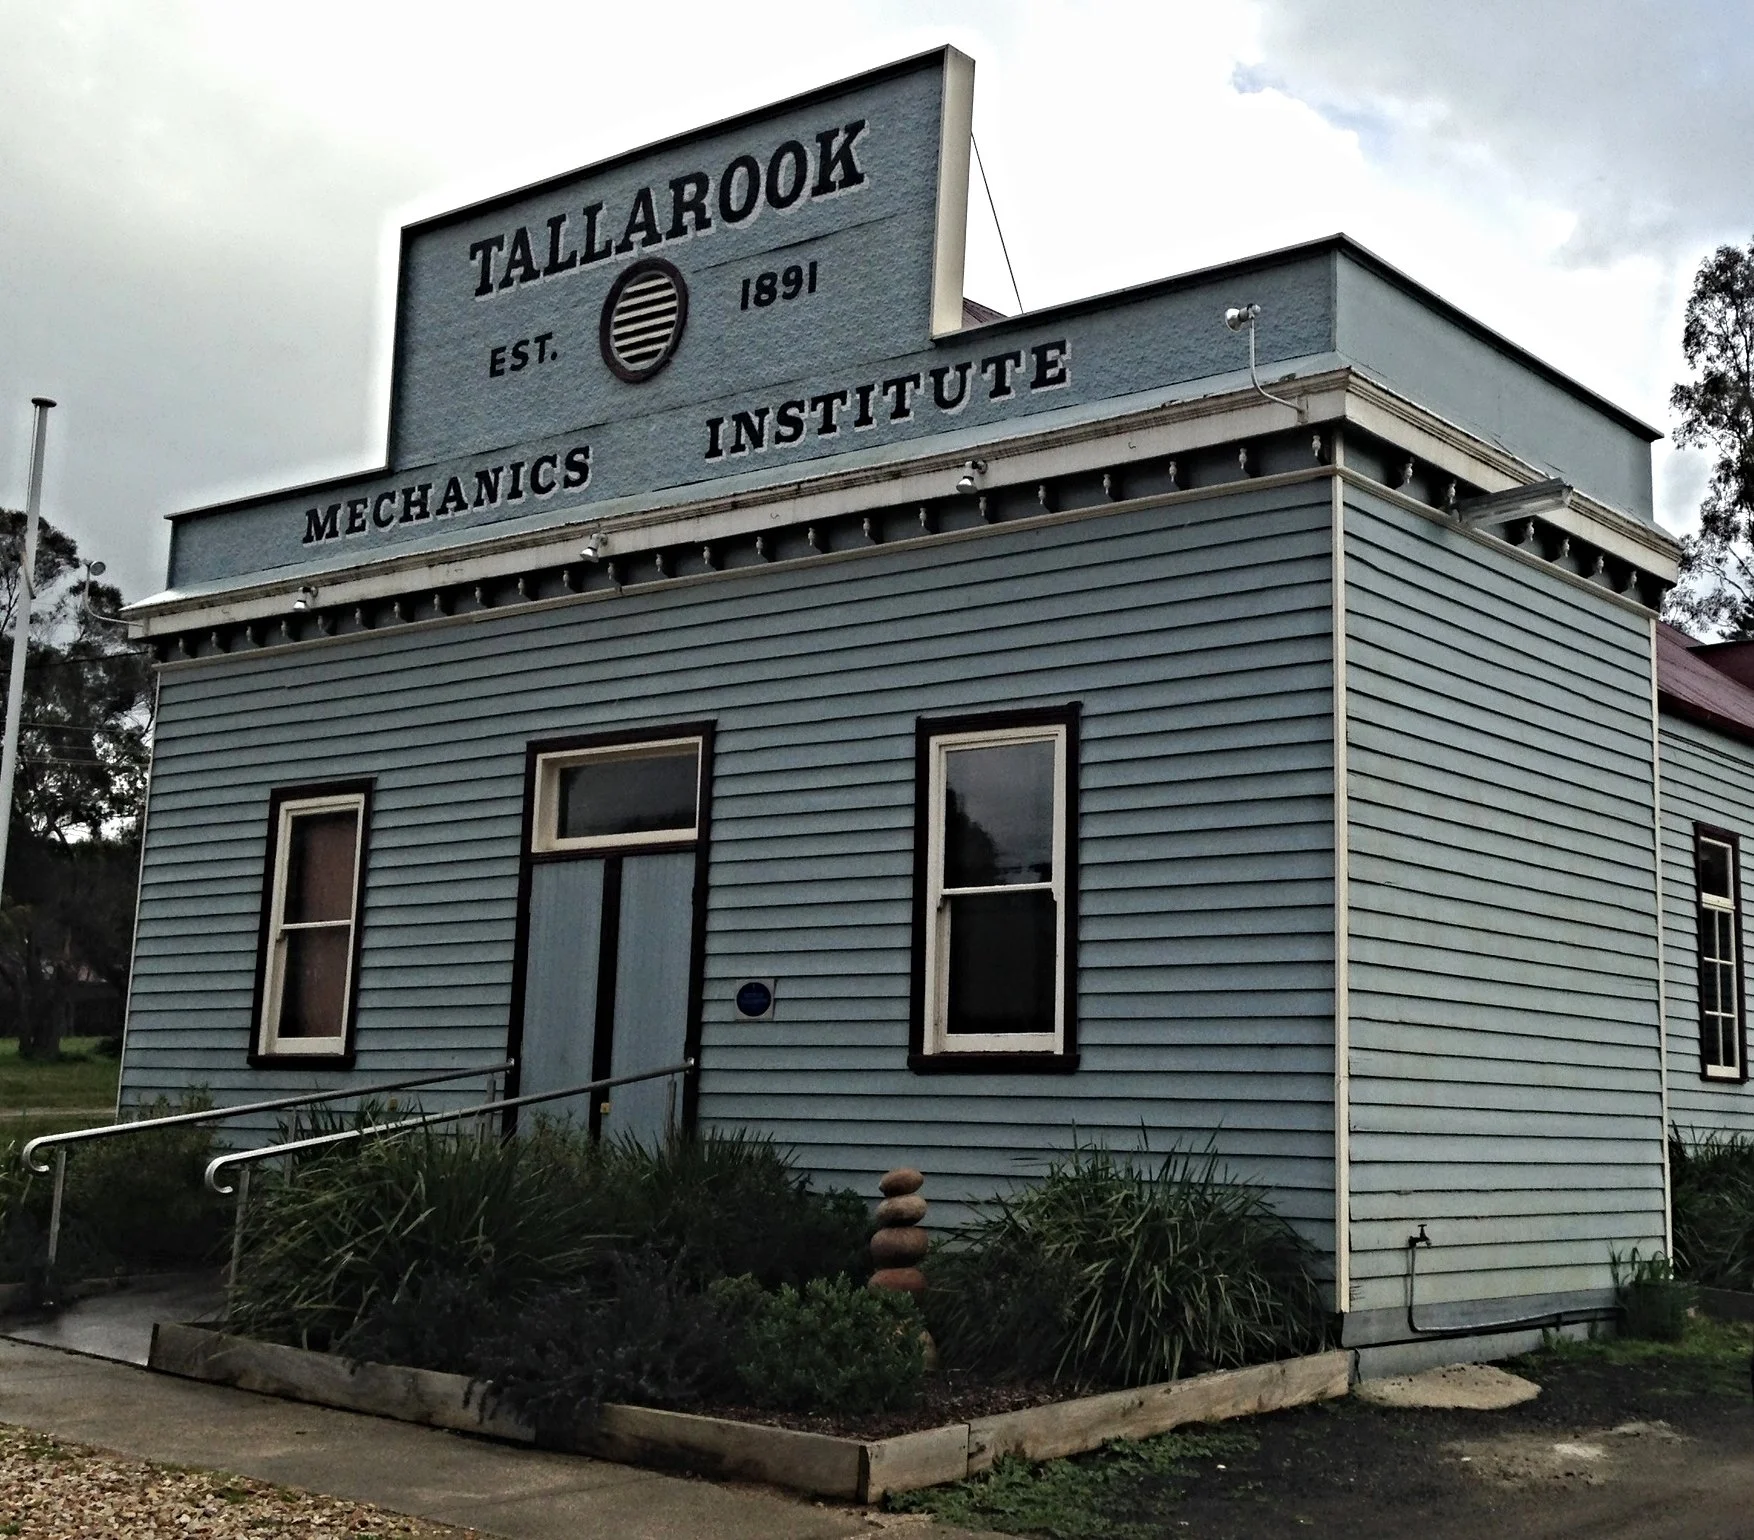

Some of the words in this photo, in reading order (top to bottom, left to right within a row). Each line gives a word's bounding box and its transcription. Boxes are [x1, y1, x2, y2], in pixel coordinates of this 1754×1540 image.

[469, 119, 869, 301] TALLAROOK
[489, 332, 558, 378] EST.
[740, 261, 818, 311] 1891
[302, 445, 594, 546] MECHANICS
[704, 338, 1072, 462] INSTITUTE
